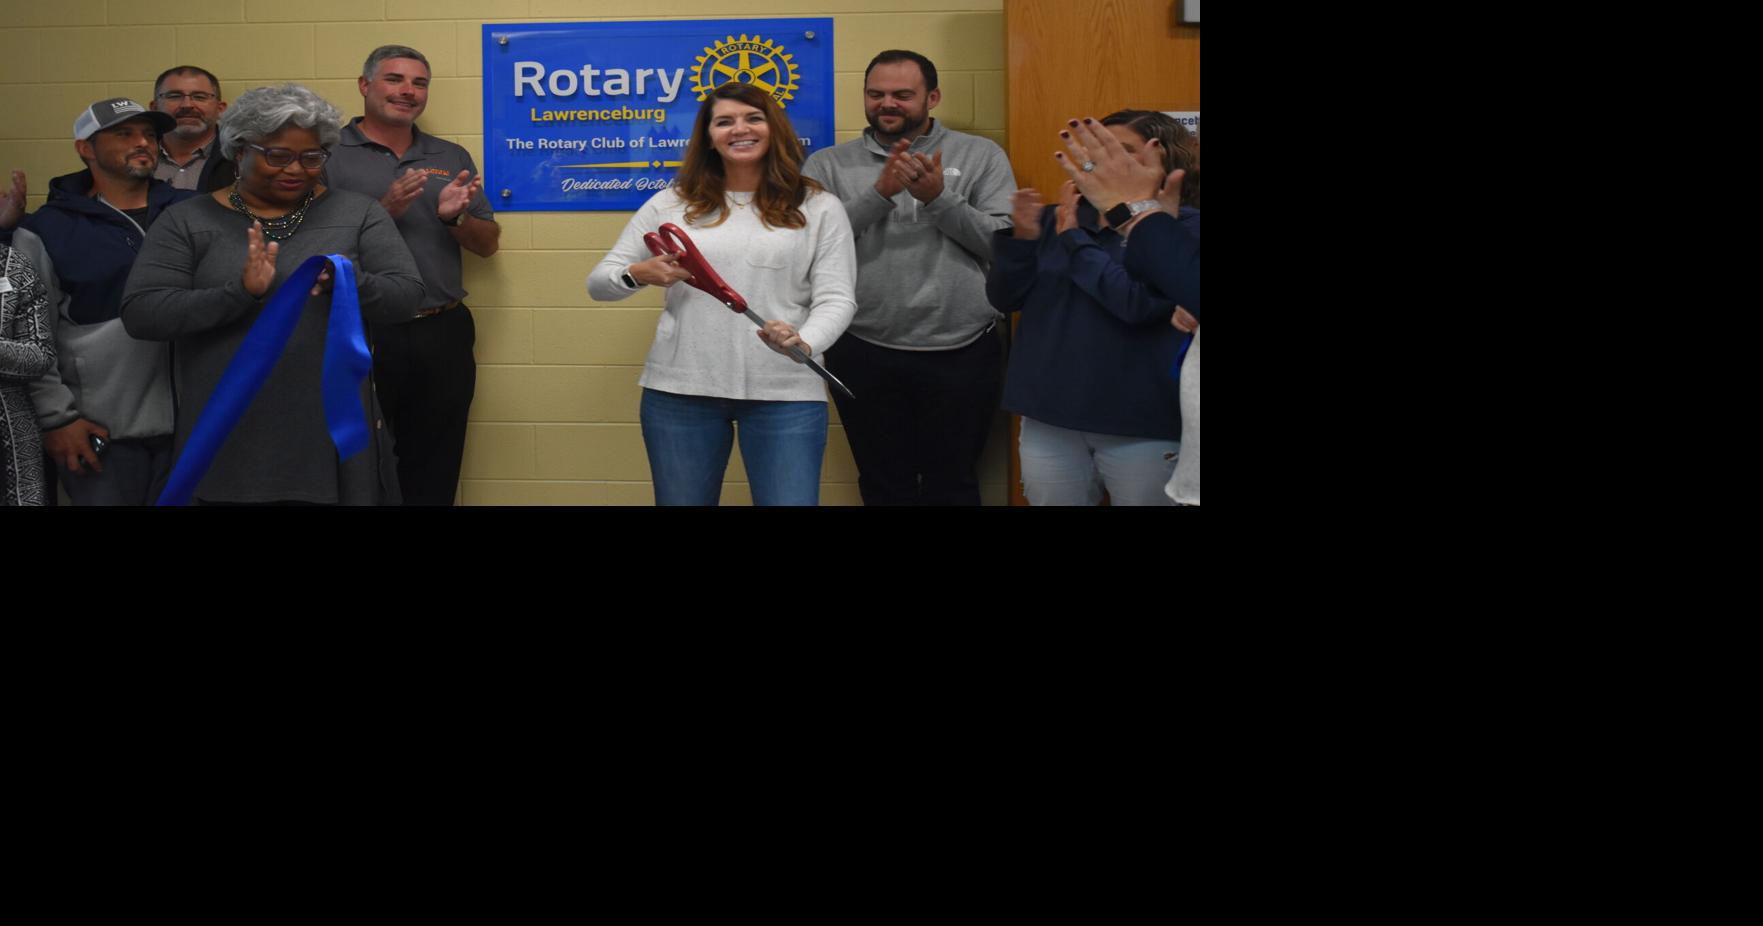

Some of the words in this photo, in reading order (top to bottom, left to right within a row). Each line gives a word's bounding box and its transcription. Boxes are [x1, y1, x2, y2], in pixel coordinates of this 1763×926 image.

[720, 43, 766, 54] ROTARY
[514, 61, 685, 102] Rotary
[531, 106, 665, 122] Lawrenceburg
[506, 138, 534, 150] The
[538, 138, 587, 151] Rotary
[591, 136, 625, 149] Club
[629, 136, 645, 148] of
[561, 177, 633, 192] Dedicated
